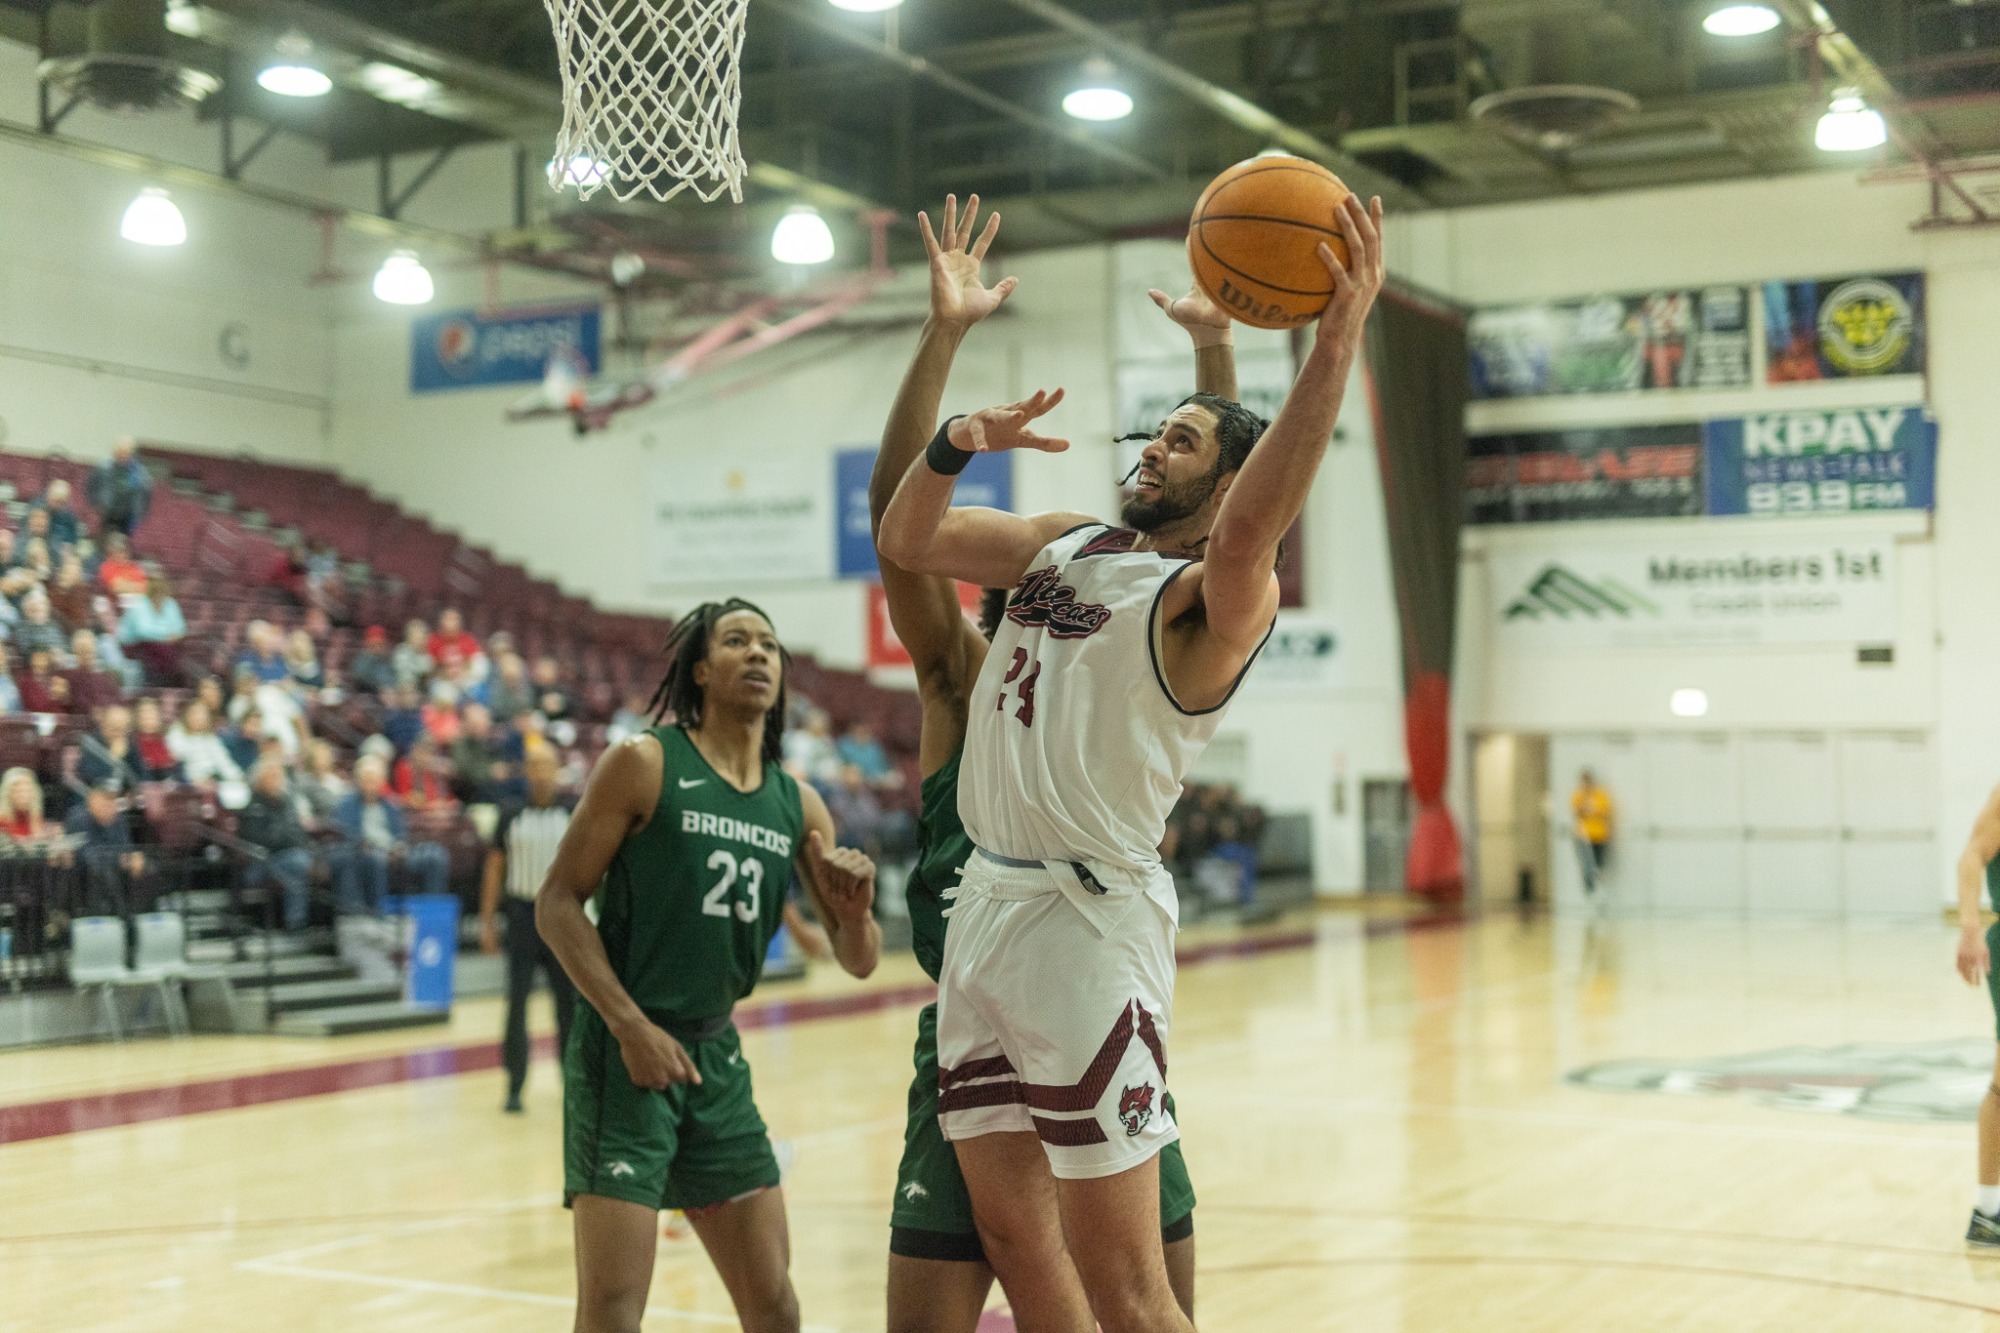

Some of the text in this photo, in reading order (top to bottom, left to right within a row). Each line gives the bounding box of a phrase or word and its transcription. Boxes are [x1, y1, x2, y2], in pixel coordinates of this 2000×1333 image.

[1743, 409, 1906, 456] KPAY
[1854, 482, 1906, 506] FM
[1649, 548, 1881, 582] Members 1st
[1006, 565, 1111, 636] Wicats
[682, 810, 792, 858] BRONCOS
[702, 850, 764, 923] 23
